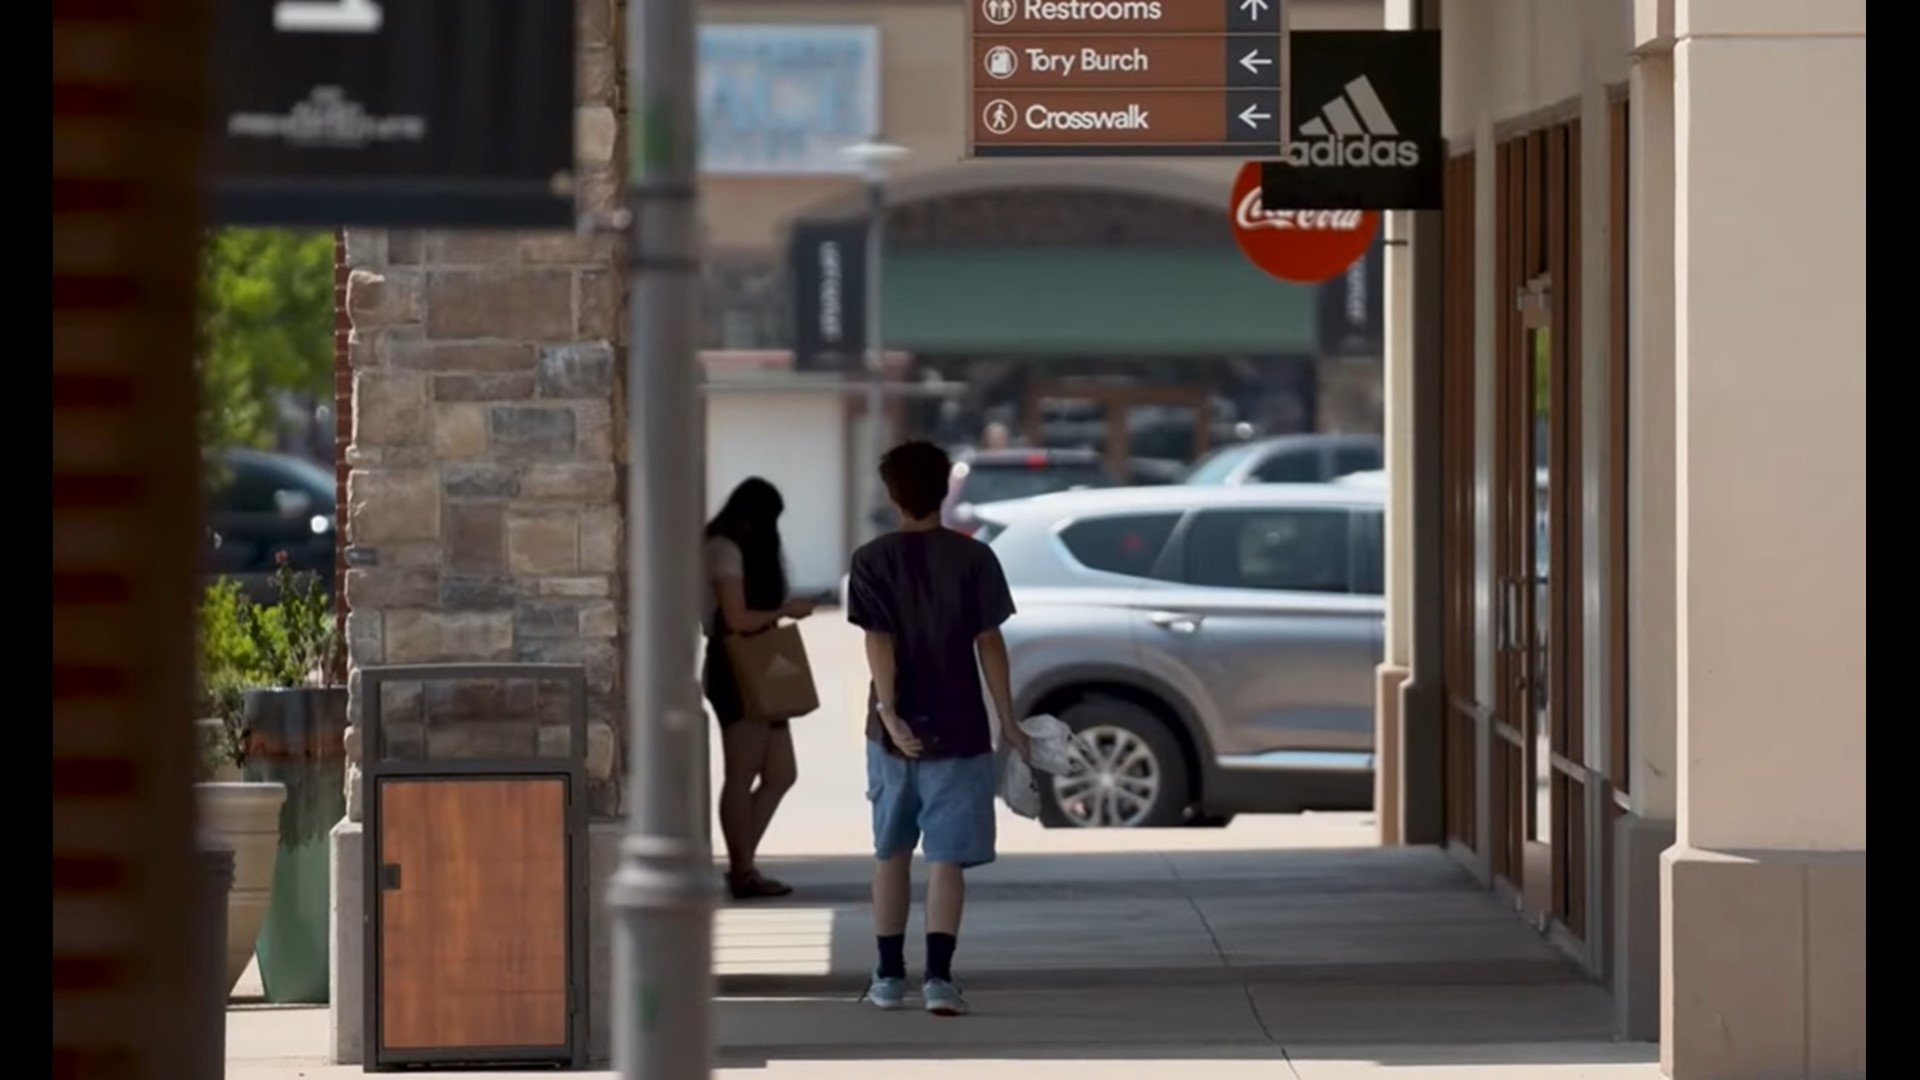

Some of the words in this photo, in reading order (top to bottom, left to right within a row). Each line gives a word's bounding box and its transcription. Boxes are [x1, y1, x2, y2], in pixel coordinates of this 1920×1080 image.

[1024, 0, 1162, 20] Restrooms
[1025, 48, 1076, 77] Tory
[1081, 47, 1149, 71] Burch
[1025, 103, 1150, 129] Crosswalk
[1288, 133, 1420, 167] adidas
